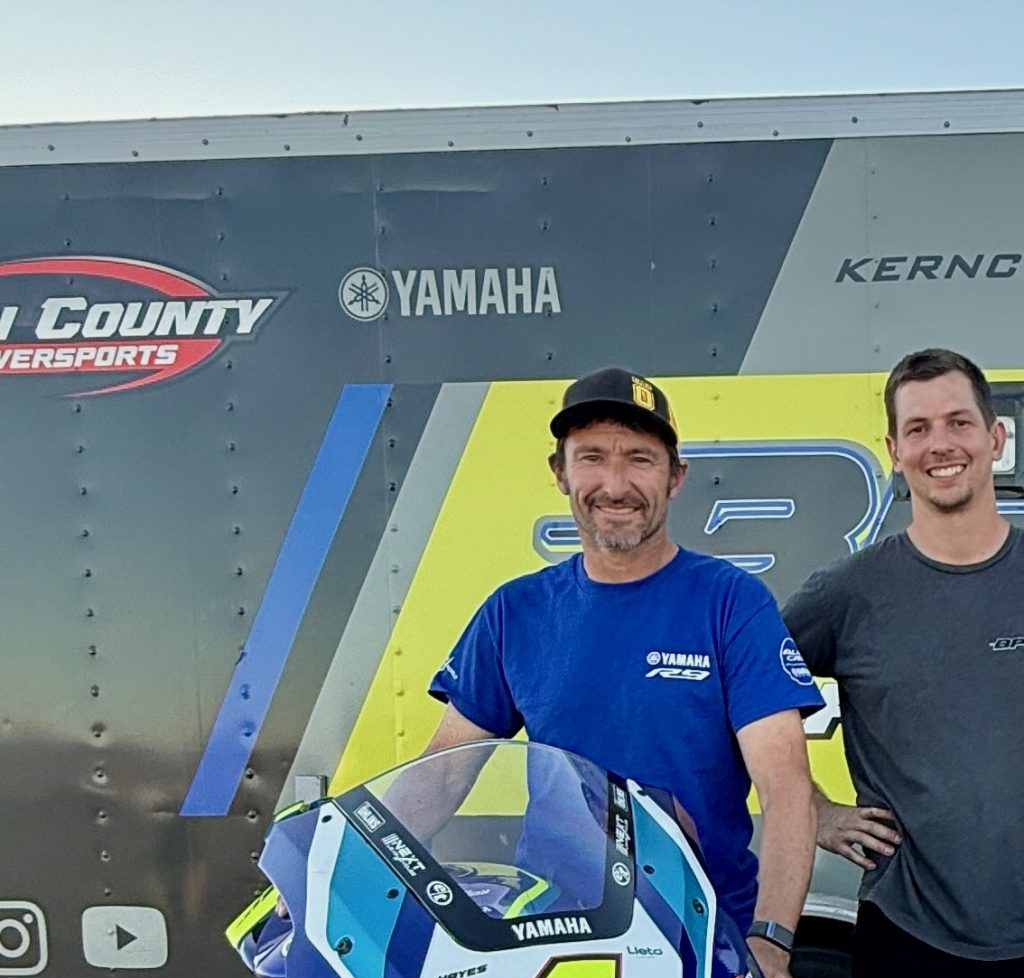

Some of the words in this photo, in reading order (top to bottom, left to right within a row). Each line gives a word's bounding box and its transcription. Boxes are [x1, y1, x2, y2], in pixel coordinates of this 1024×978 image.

[393, 267, 562, 316] YAMAHA
[662, 652, 711, 668] YAMAHA
[645, 667, 711, 681] R9
[511, 916, 592, 941] YAMAHA
